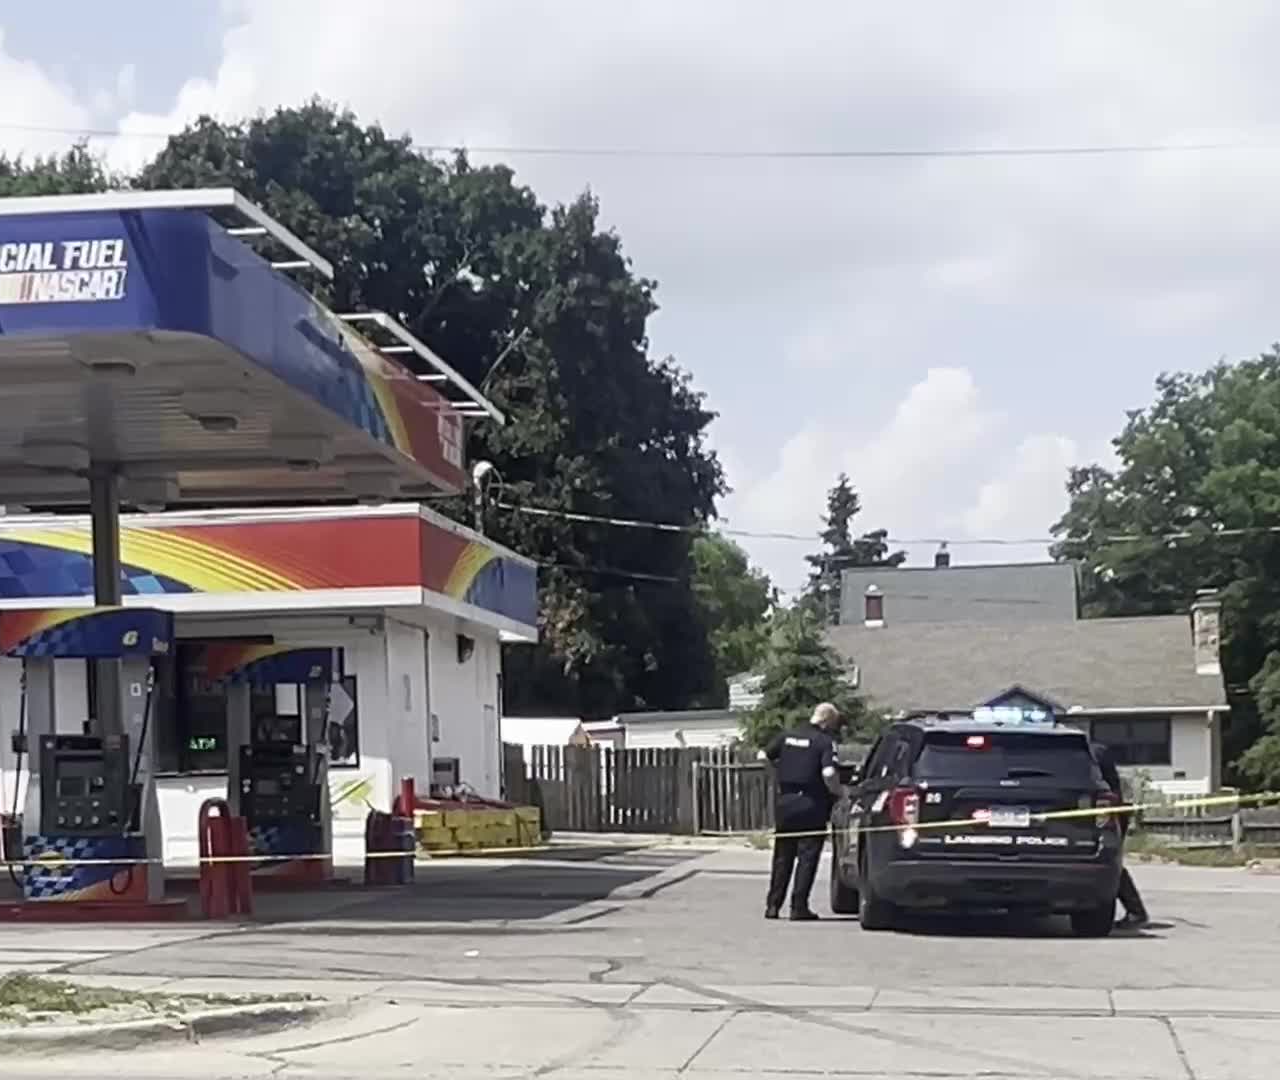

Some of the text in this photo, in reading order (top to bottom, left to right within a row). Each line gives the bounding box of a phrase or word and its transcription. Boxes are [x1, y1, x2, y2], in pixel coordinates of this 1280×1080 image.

[62, 239, 128, 269] FUEL
[31, 270, 127, 300] NASCAR
[188, 737, 216, 751] ATM
